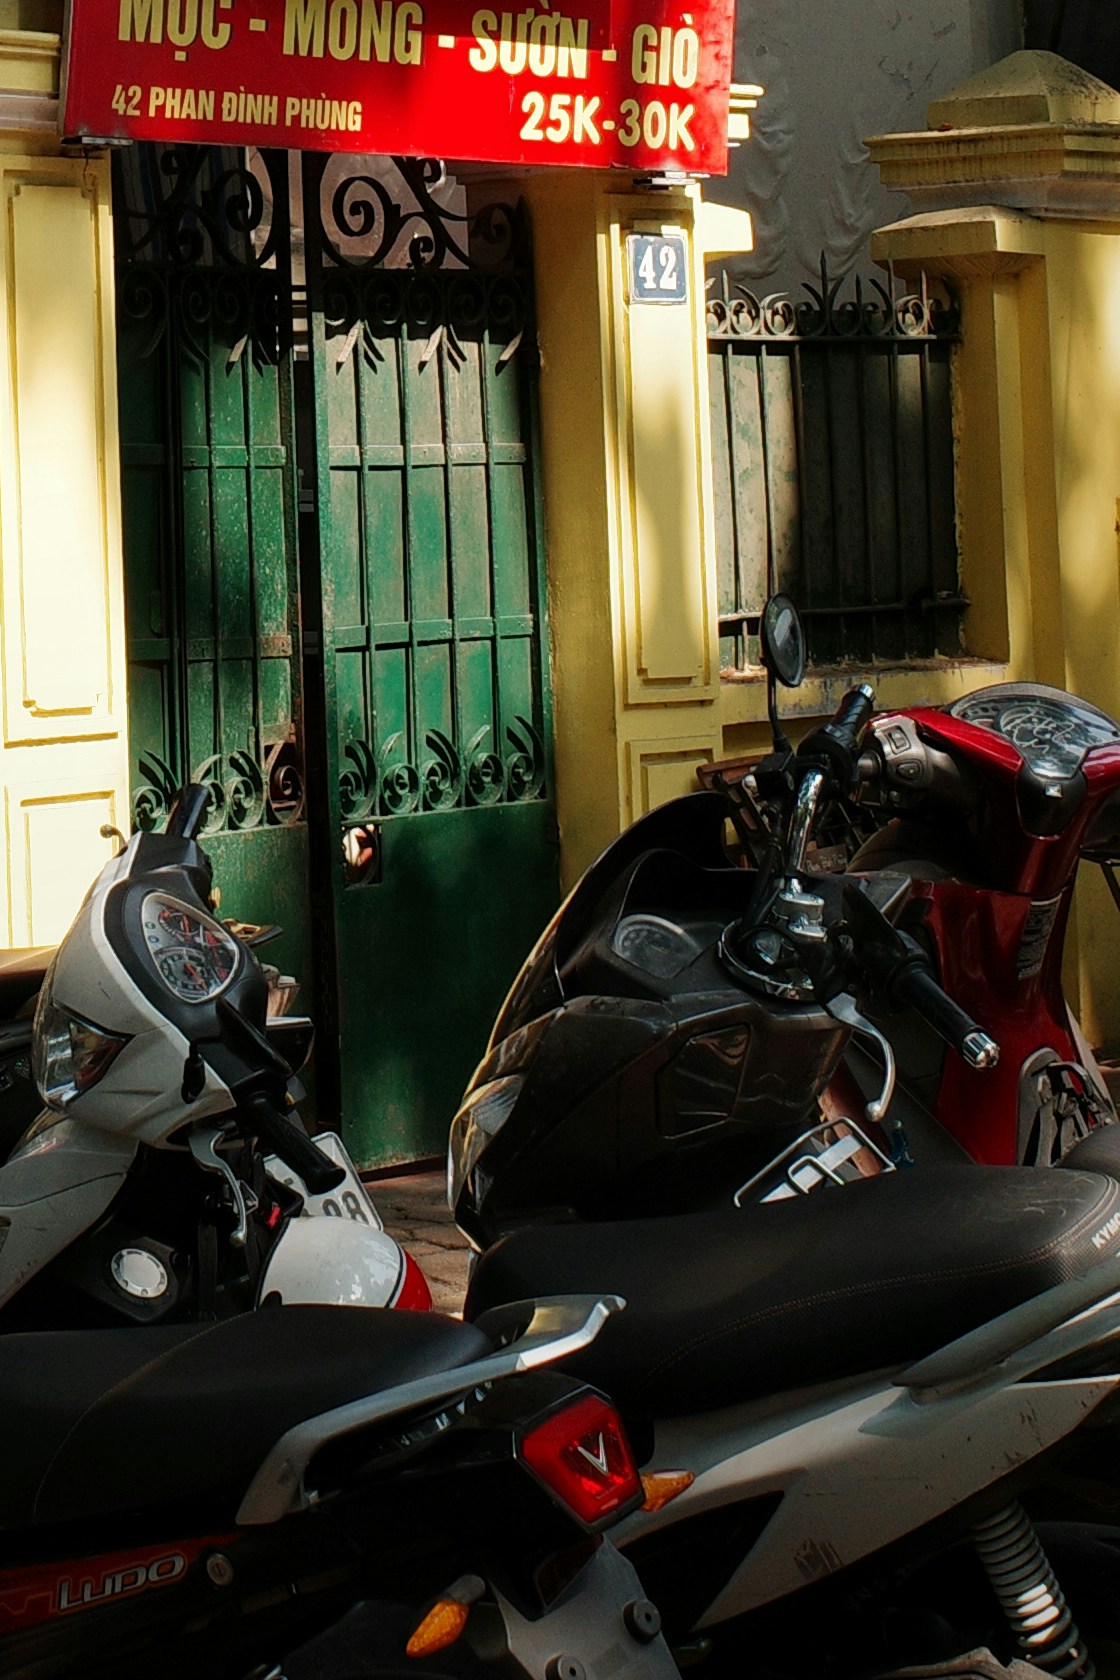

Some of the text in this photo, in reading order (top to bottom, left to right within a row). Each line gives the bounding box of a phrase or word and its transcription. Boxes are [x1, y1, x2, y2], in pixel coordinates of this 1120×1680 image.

[631, 13, 700, 89] GIÒ
[111, 84, 363, 131] 42 PHAN ĐÌNH PHÙNG
[519, 90, 696, 152] 25K-30K
[637, 245, 678, 291] 42
[59, 1553, 186, 1611] LUDO
